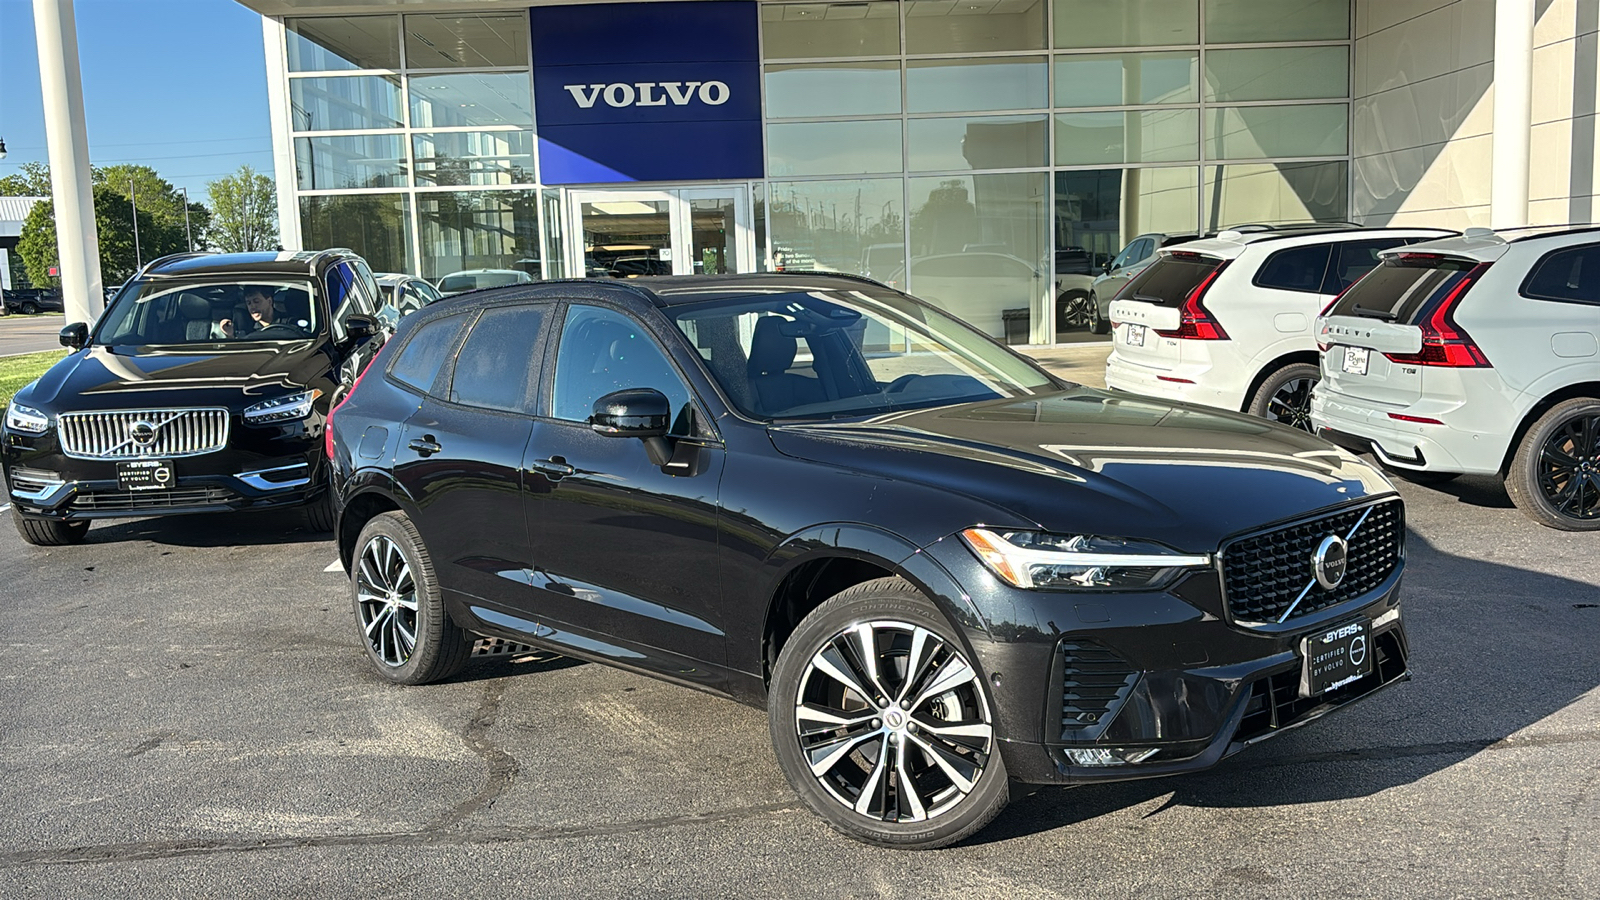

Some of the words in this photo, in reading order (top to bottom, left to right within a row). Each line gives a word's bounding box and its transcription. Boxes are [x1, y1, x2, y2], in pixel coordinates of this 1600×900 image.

[564, 81, 731, 108] VOLVO
[1328, 327, 1371, 338] VOLVO
[850, 603, 938, 621] CONTINENTAL
[1326, 623, 1358, 643] BYERS
[1314, 668, 1322, 676] BY
[1324, 660, 1344, 672] VOLVO
